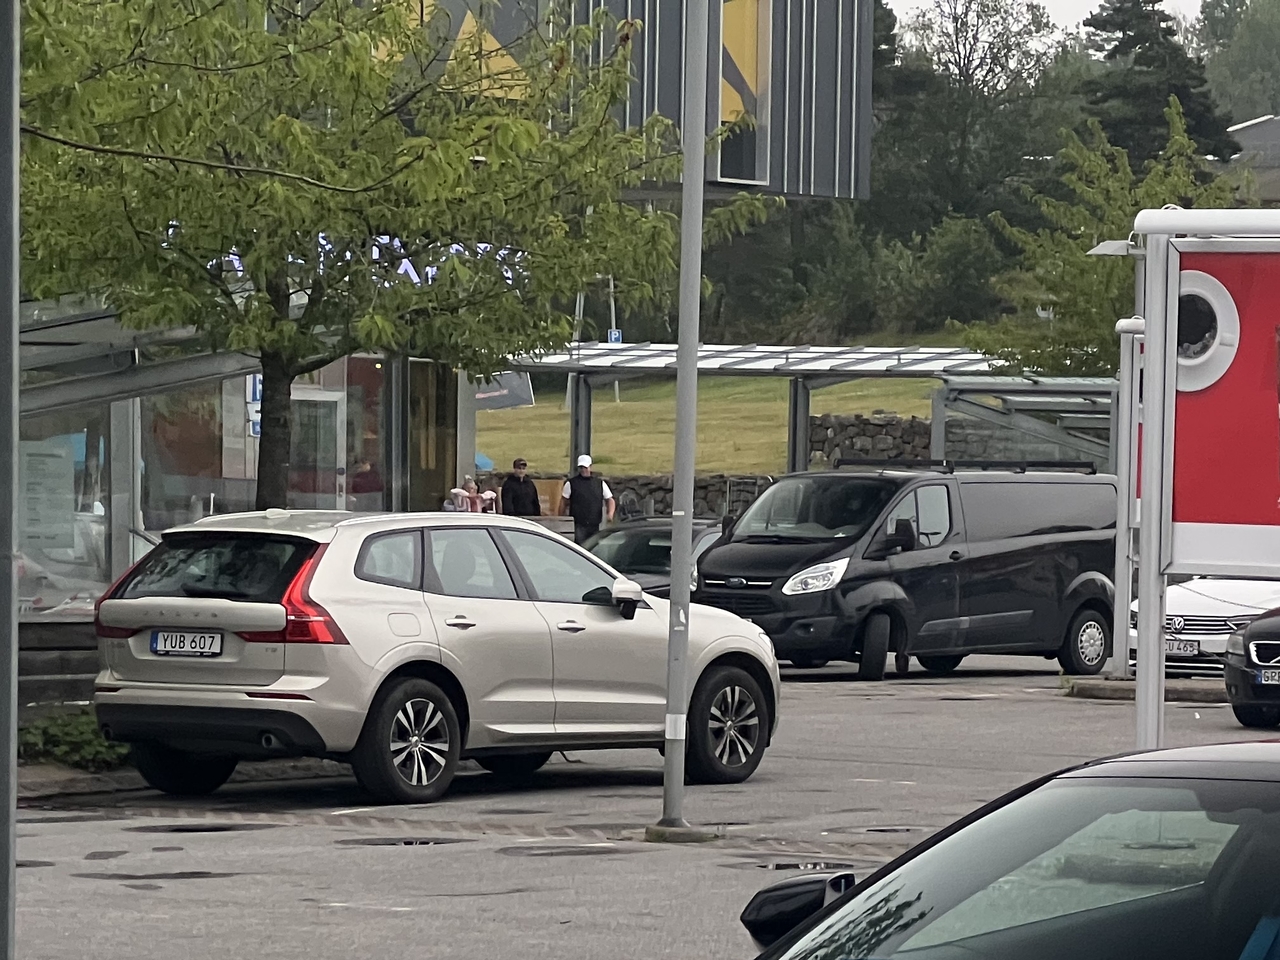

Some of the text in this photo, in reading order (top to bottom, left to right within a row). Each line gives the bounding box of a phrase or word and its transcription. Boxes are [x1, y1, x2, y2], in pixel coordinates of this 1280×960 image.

[611, 331, 619, 341] P
[163, 634, 215, 651] YUB 607
